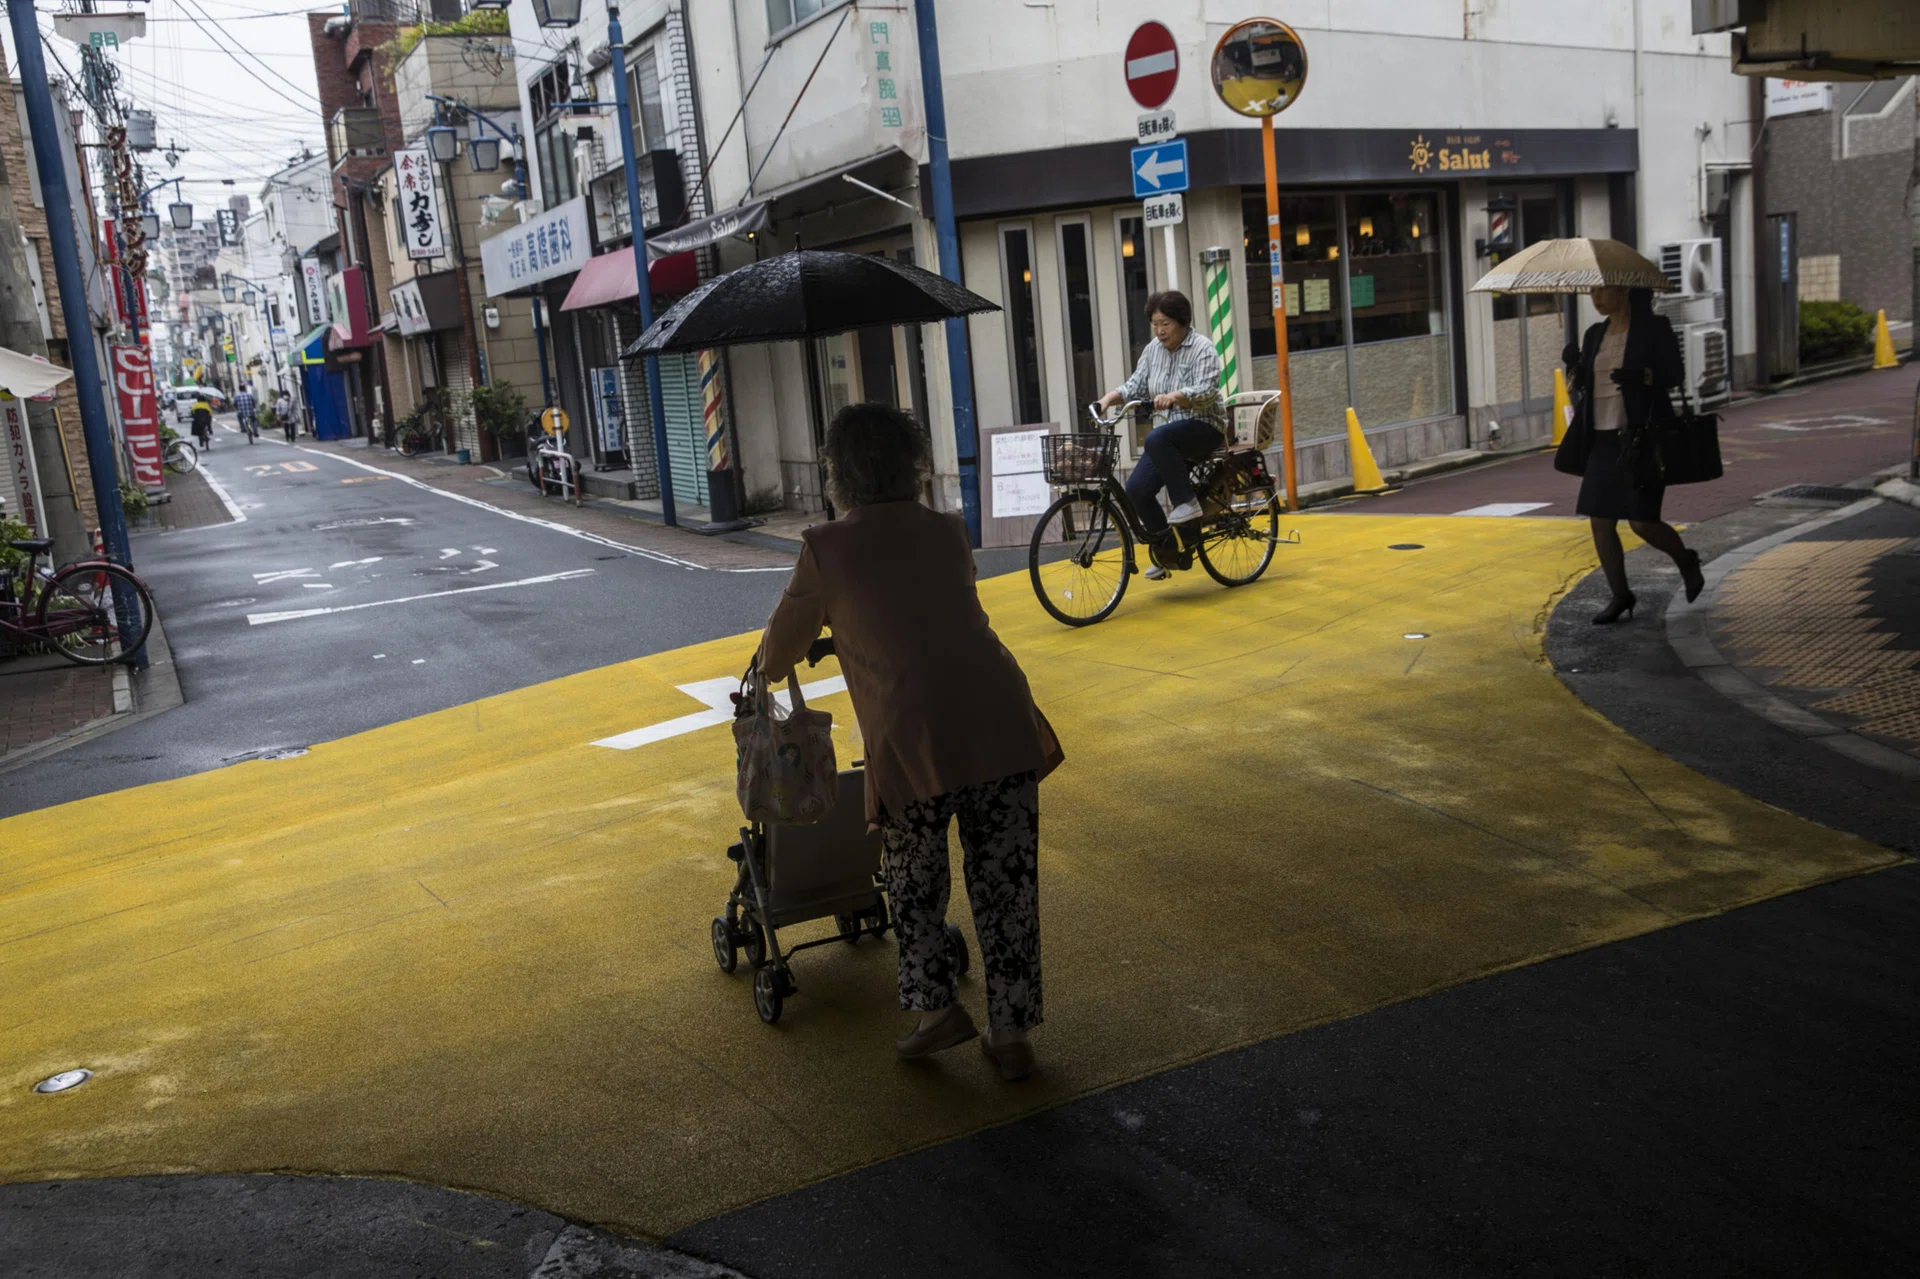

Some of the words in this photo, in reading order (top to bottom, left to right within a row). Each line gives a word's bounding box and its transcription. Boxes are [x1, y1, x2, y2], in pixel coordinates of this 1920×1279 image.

[1138, 116, 1175, 138] 自転車を除く
[1439, 147, 1491, 171] Salut
[1145, 202, 1182, 222] 自転車を除く
[526, 215, 573, 273] 高橋歯科
[243, 460, 320, 477] 20
